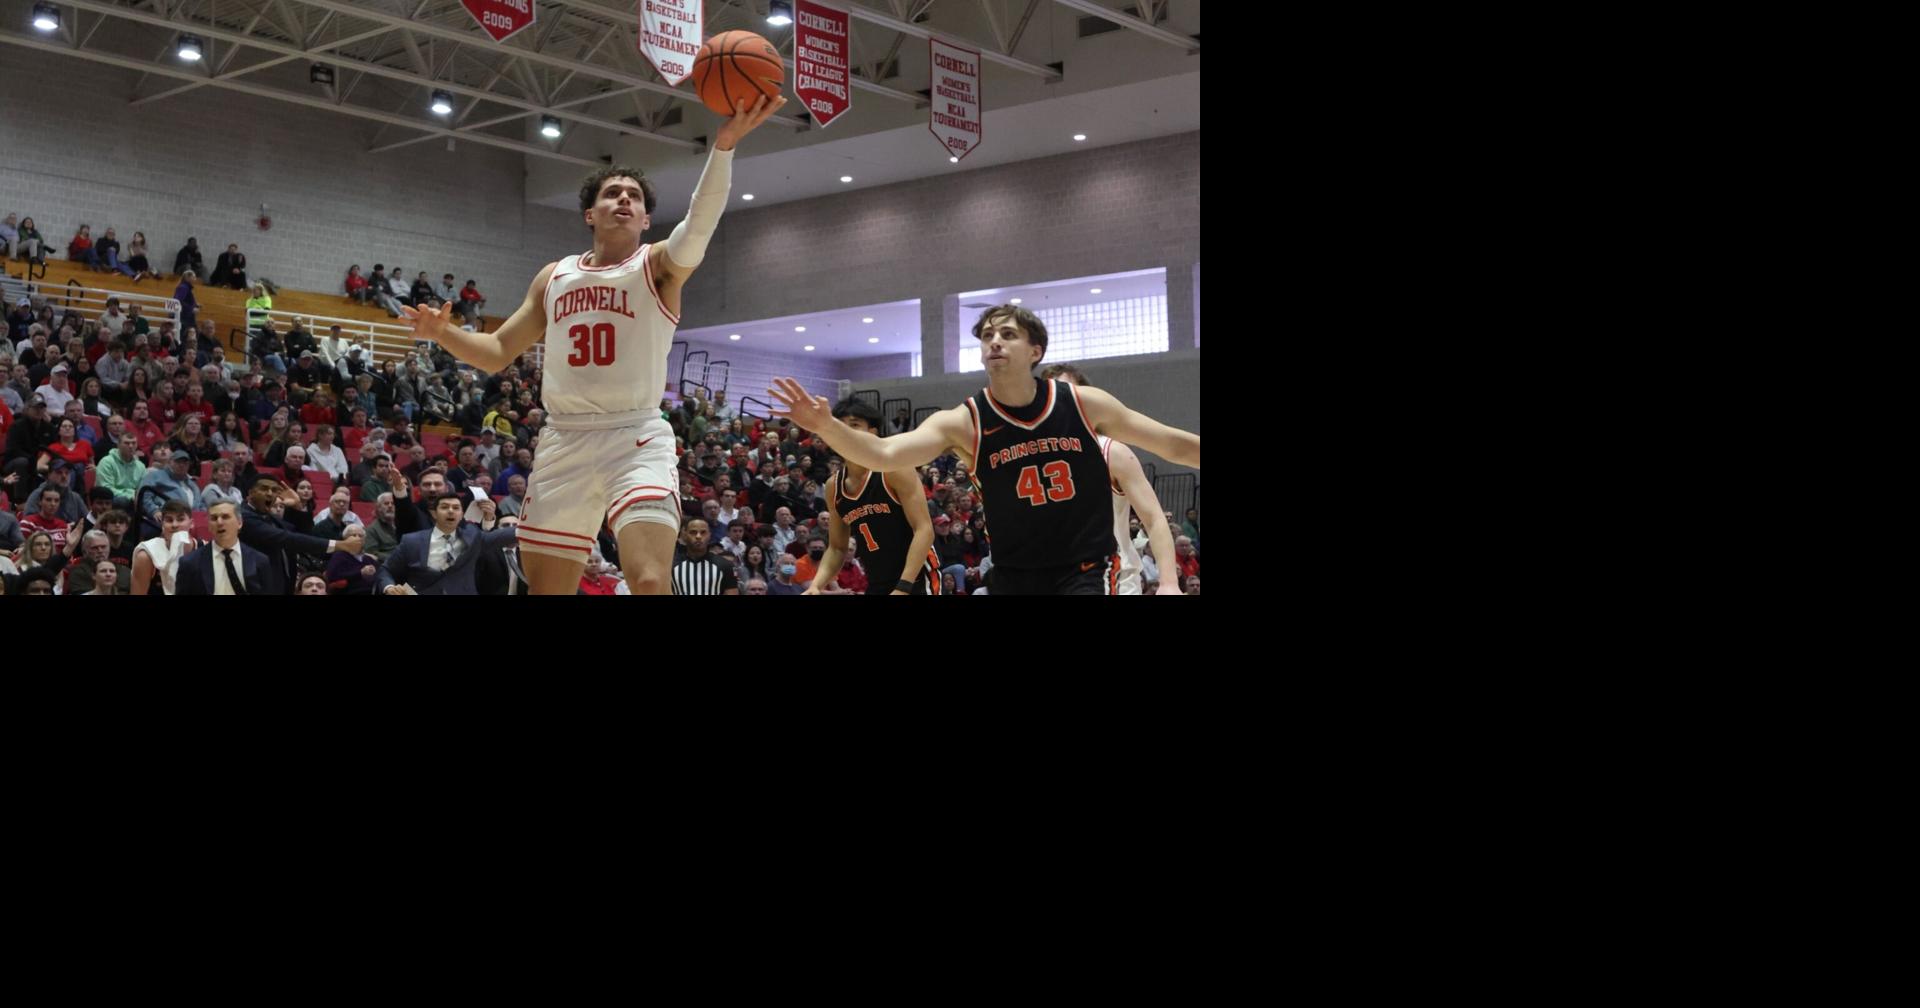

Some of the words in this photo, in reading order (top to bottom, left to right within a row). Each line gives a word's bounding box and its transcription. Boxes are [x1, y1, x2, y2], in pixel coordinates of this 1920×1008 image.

[483, 11, 513, 30] 2009
[660, 21, 683, 39] NCAA
[800, 11, 846, 36] CORNELL
[805, 34, 839, 53] WOMEN'S
[661, 60, 684, 76] 2009
[799, 46, 846, 69] BASKETBALL
[935, 53, 976, 77] CORNELL
[800, 61, 813, 74] IVY
[816, 65, 844, 82] LEAGUE
[799, 74, 846, 100] CHAMPIONS
[936, 85, 976, 105] BASKETBALL
[942, 76, 970, 92] WOMEN'S
[811, 98, 833, 114] 2008
[948, 103, 965, 117] NCAA
[933, 111, 979, 134] TOURNAMENT
[554, 286, 635, 323] CORNELL
[568, 323, 615, 367] 30
[990, 437, 1082, 469] PRINCETON
[1016, 460, 1076, 506] 43
[859, 523, 880, 552] 1
